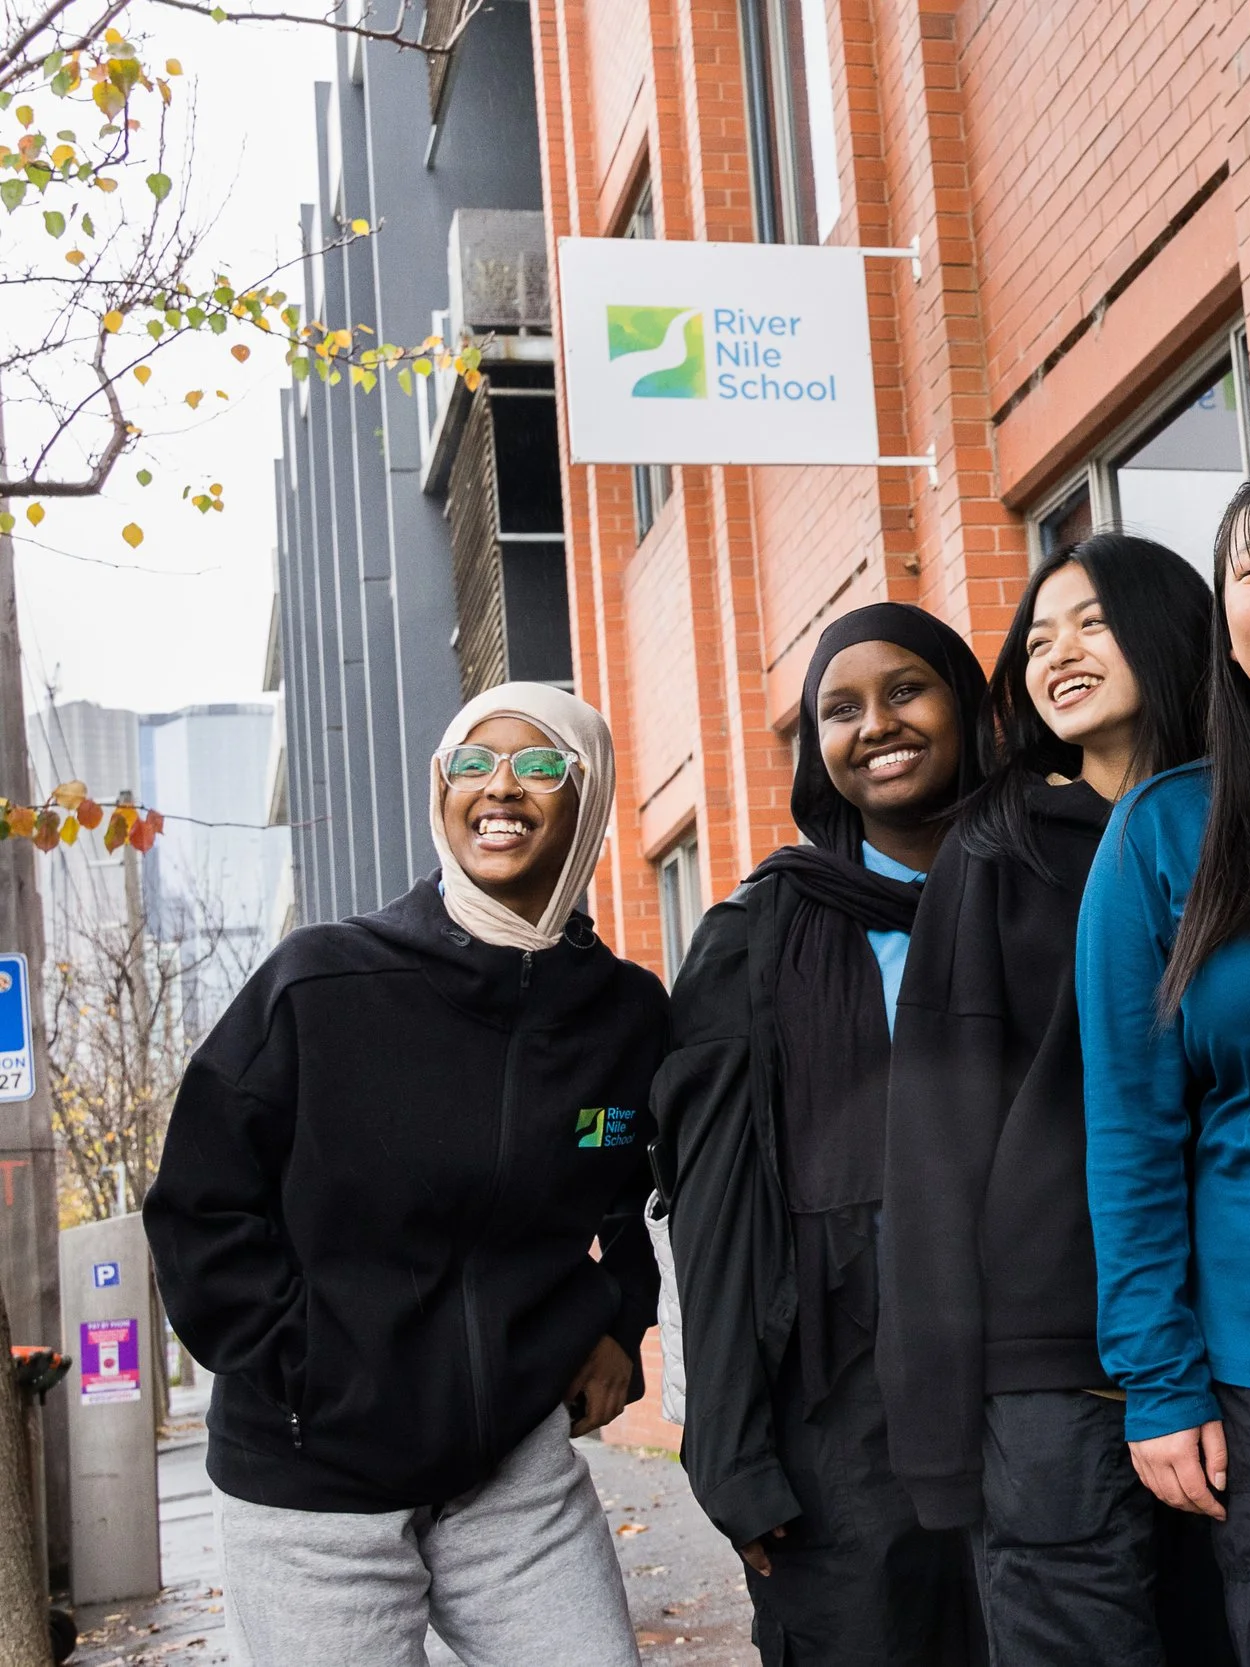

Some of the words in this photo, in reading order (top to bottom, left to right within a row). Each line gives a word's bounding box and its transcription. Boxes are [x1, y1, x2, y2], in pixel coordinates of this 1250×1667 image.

[714, 308, 801, 337] River
[716, 341, 782, 368] Nile
[718, 373, 837, 402] School
[607, 1107, 636, 1120] River
[606, 1121, 627, 1133] Nile
[604, 1132, 636, 1147] School
[97, 1265, 115, 1286] P
